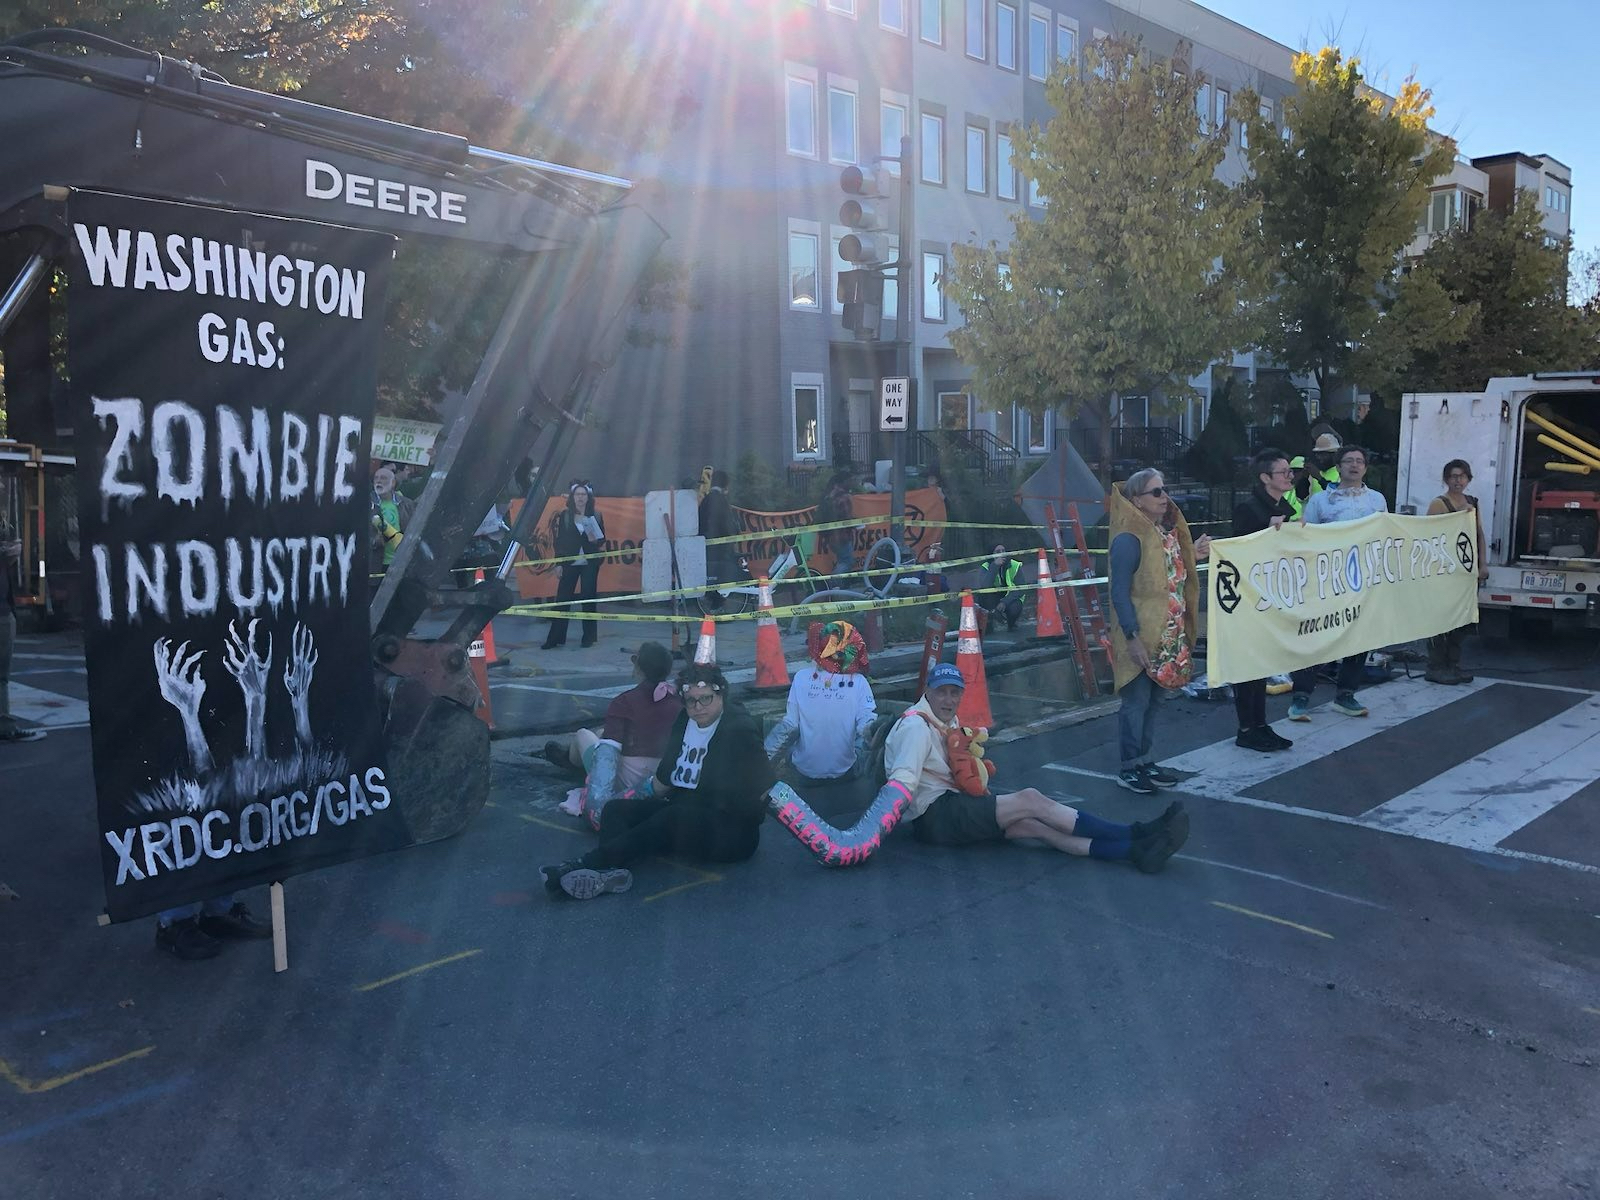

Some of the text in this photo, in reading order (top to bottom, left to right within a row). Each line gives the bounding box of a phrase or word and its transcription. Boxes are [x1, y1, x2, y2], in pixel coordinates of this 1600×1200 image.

[306, 159, 467, 224] DEERE
[74, 223, 366, 319] WASHINGTON
[198, 312, 285, 370] GAS:
[885, 383, 902, 394] ONE
[885, 398, 903, 407] WAY
[92, 395, 362, 513] ZOMBIE
[373, 445, 425, 462] PLANET
[384, 432, 415, 446] DEAD
[92, 532, 357, 625] INDUSTRY
[1249, 533, 1457, 612] STOP PROJECT PIPES
[105, 766, 392, 886] XRDC.ORG/GAS
